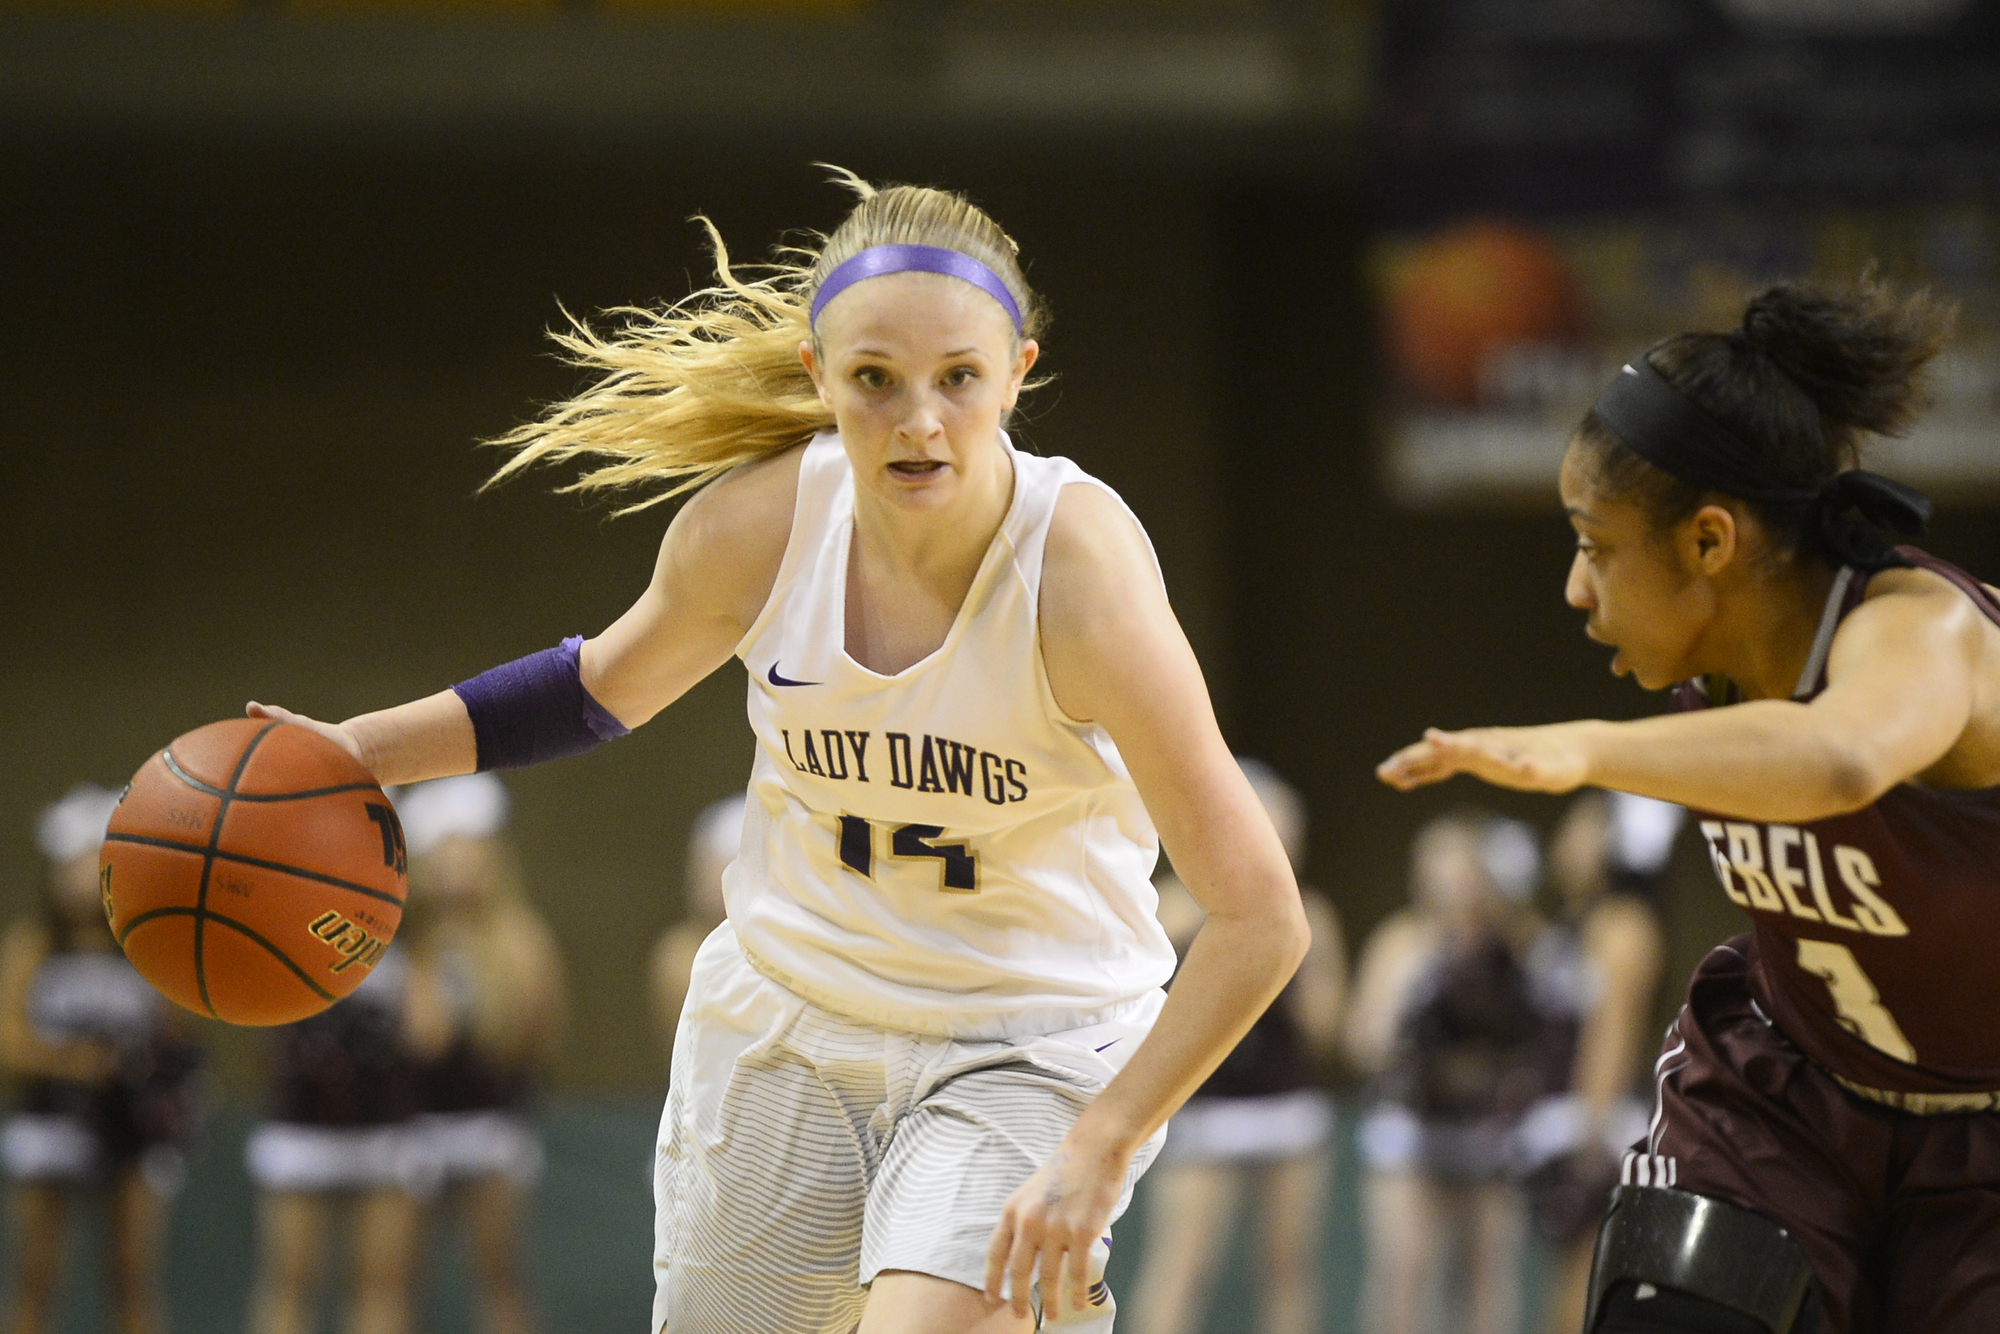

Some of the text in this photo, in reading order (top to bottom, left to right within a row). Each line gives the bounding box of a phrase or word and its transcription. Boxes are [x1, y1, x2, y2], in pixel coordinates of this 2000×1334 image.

[781, 729, 1028, 805] LADY DAWGS
[833, 808, 981, 894] 14
[1700, 820, 1910, 937] EBELS
